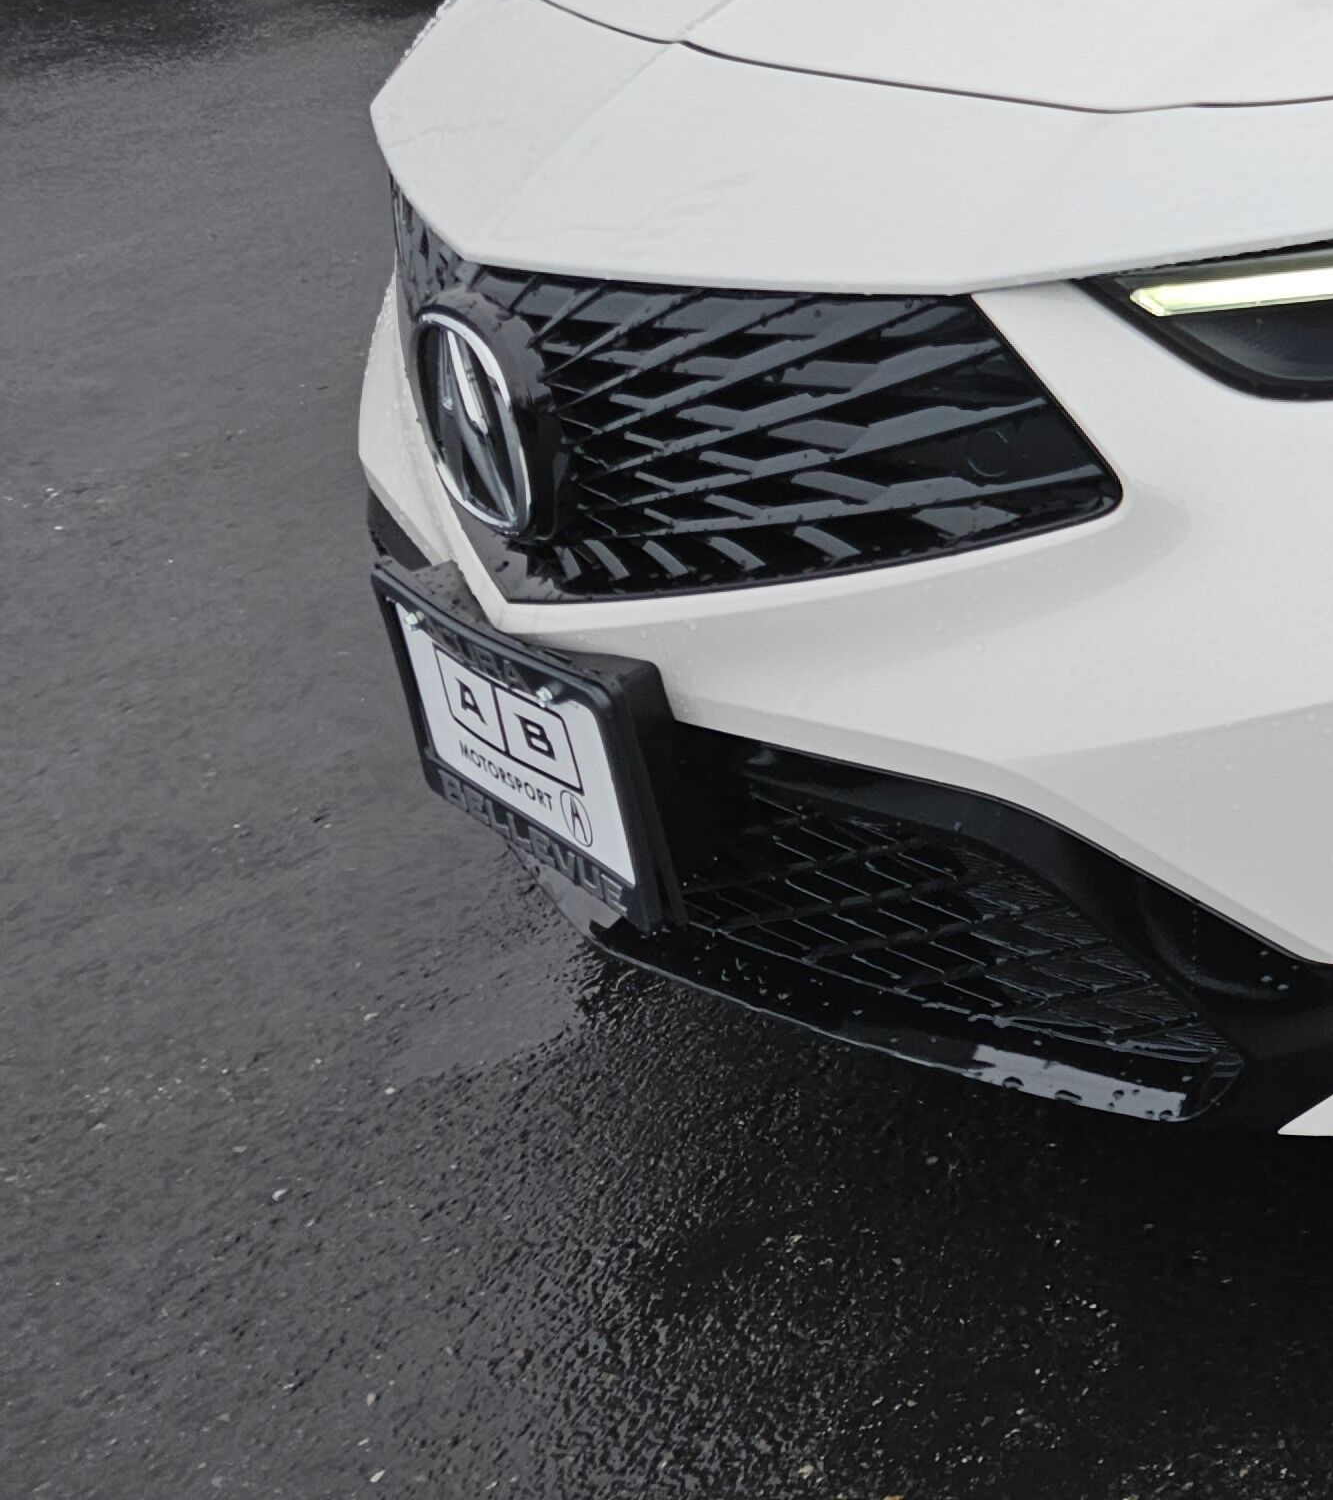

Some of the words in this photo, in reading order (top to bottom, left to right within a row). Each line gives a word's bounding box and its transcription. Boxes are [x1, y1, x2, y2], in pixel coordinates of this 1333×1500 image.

[456, 677, 486, 725] A
[514, 712, 557, 762] B
[459, 740, 555, 812] MOTORSPORT
[438, 770, 629, 918] BELLEVUE
